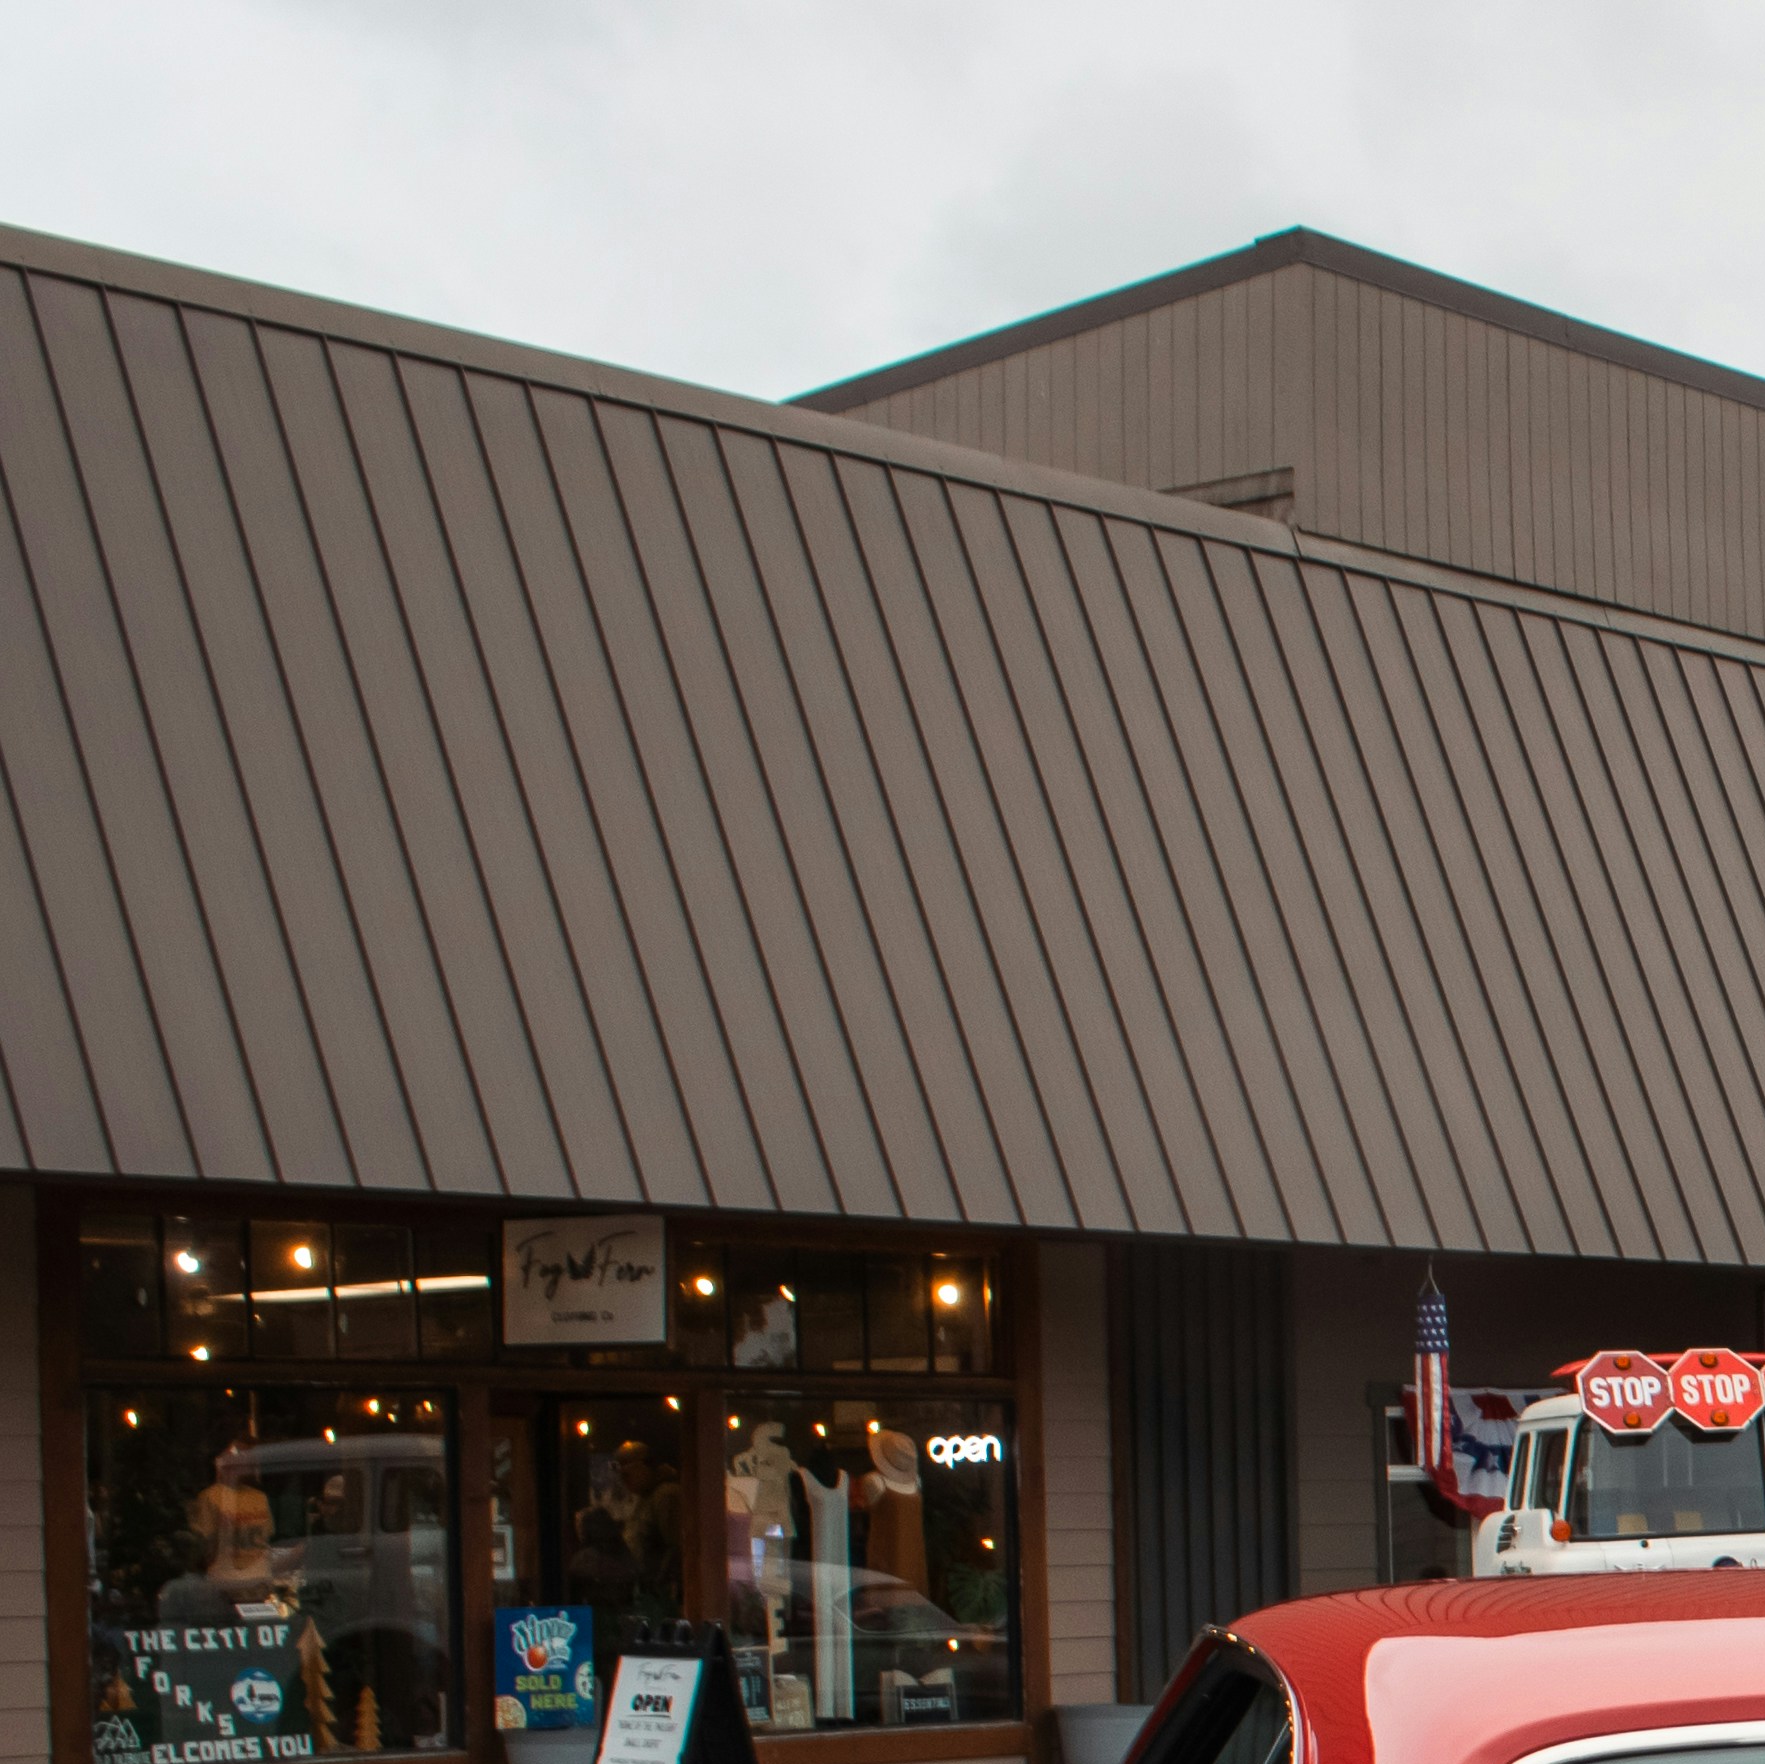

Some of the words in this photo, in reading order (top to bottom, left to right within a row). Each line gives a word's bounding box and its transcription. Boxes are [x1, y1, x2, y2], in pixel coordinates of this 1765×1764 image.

[1590, 1377, 1661, 1407] STOP
[1681, 1375, 1751, 1404] STOP
[927, 1434, 1002, 1469] open
[125, 1629, 177, 1652] THE
[184, 1627, 248, 1649] CITY
[257, 1625, 289, 1647] OF
[134, 1656, 236, 1736] FORKS
[515, 1675, 562, 1691] SOLD
[530, 1693, 577, 1709] HERE
[631, 1694, 673, 1712] OPEN
[265, 1734, 313, 1757] YOU
